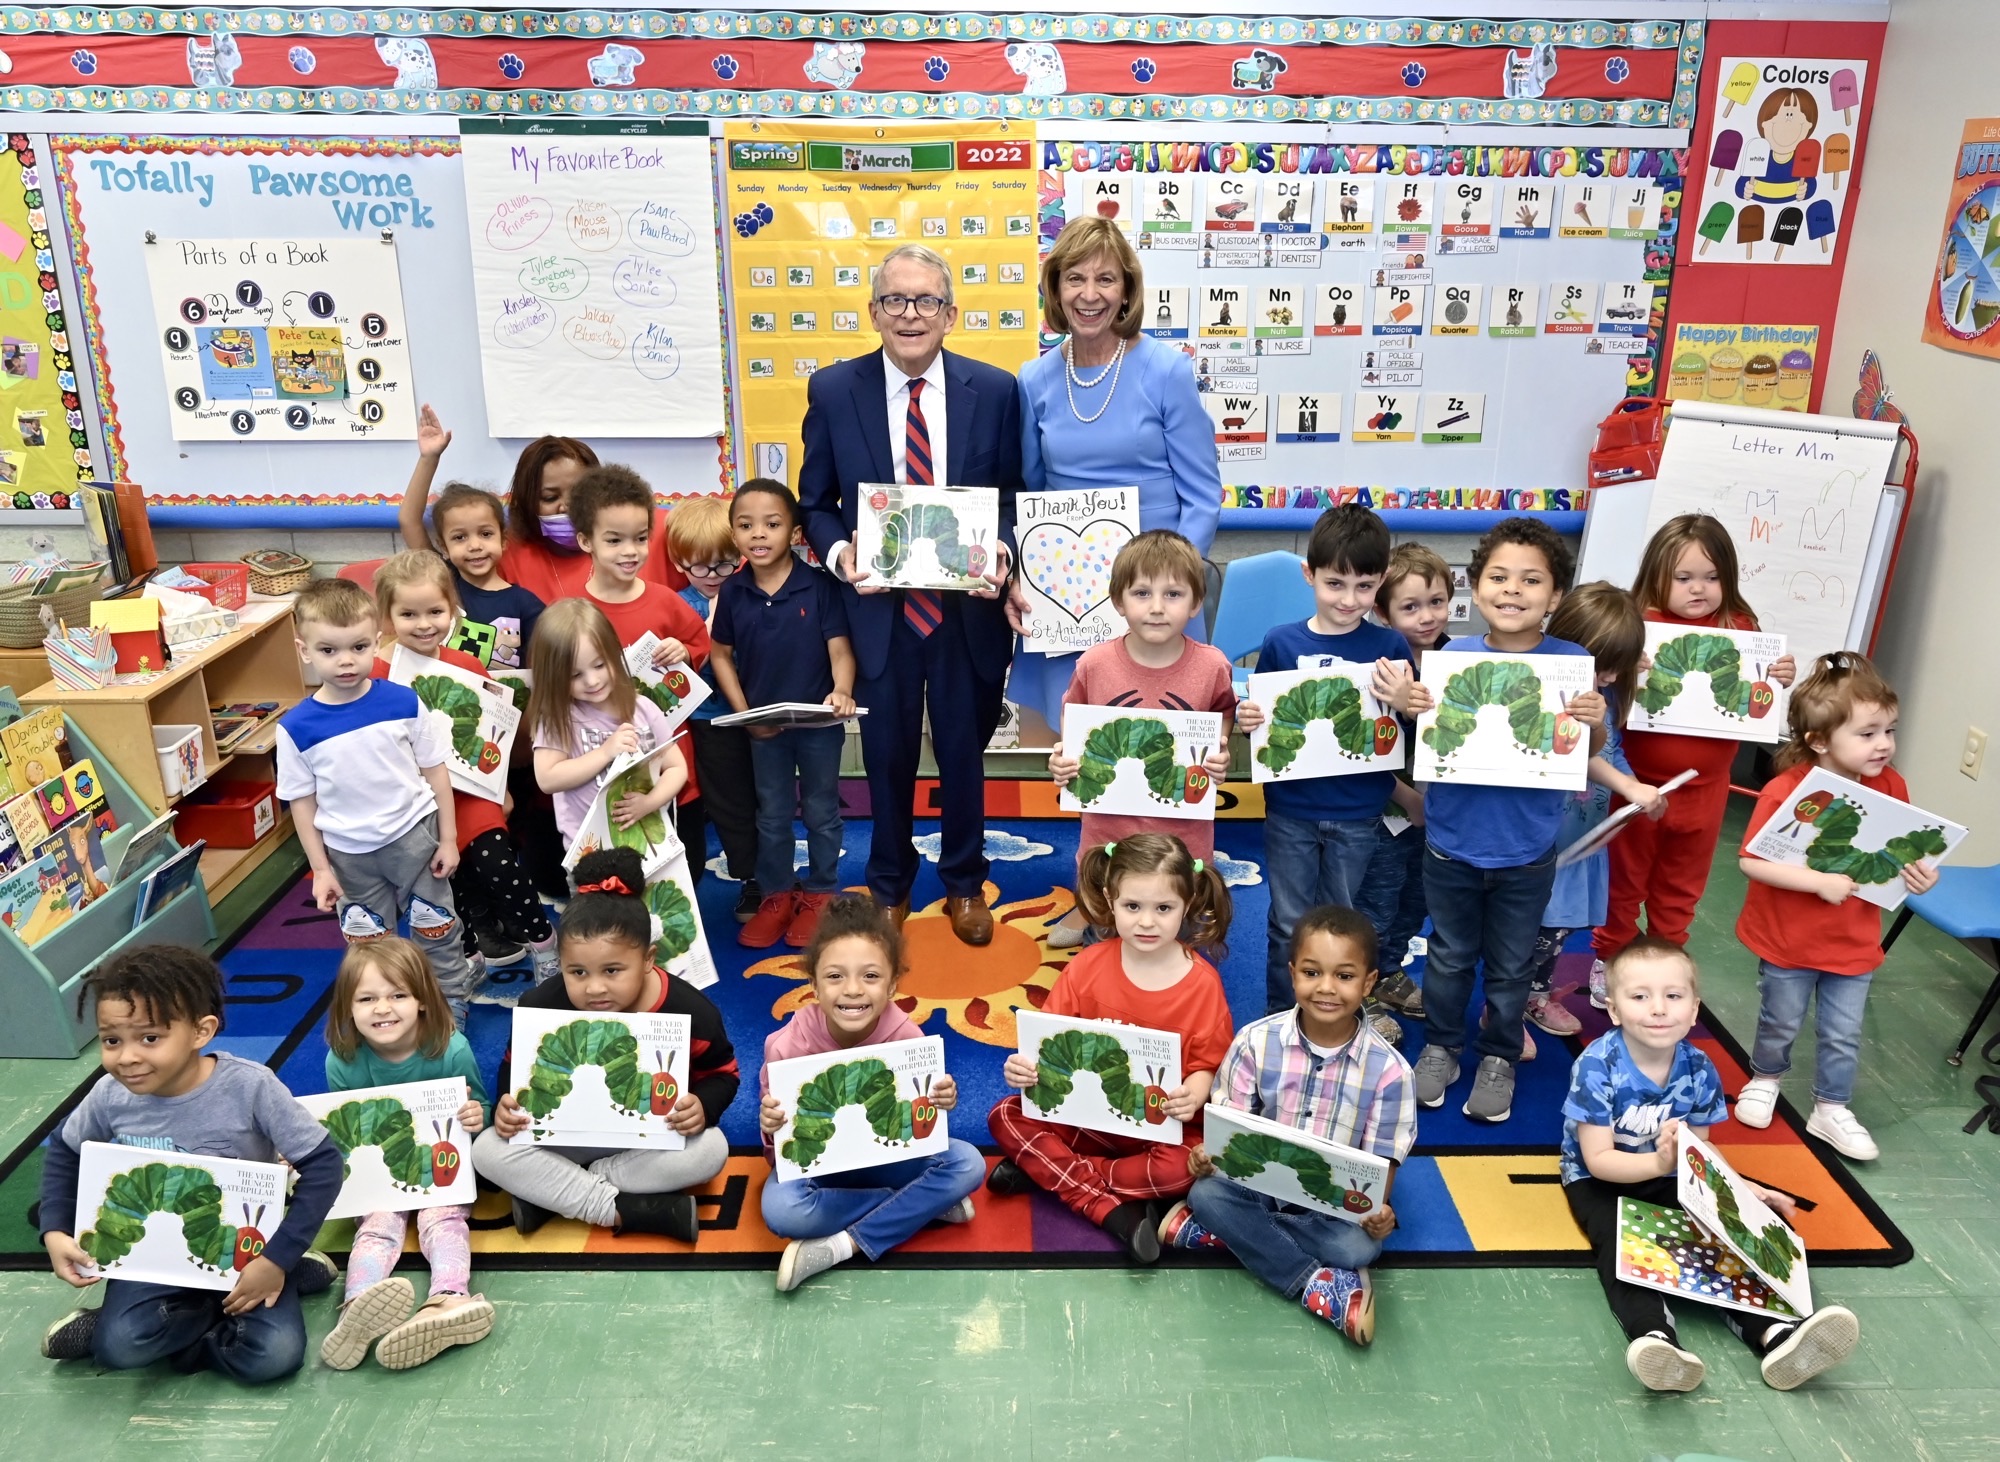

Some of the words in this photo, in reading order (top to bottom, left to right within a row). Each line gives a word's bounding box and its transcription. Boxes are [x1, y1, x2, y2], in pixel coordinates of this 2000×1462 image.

[1763, 64, 1830, 85] Colors
[1730, 80, 1751, 88] yellow
[1983, 126, 1997, 138] Life
[740, 148, 798, 163] Spring
[966, 147, 1022, 162] 2022
[511, 146, 539, 184] My
[620, 147, 665, 170] Book
[862, 155, 910, 168] March
[90, 160, 213, 207] Totally
[248, 164, 414, 197] Pawsome
[737, 184, 765, 194] Sunday
[777, 184, 809, 194] Monday
[822, 184, 852, 194] Tuesday
[858, 183, 902, 193] Wednesday
[906, 182, 941, 192] Thursday
[955, 182, 980, 191] Friday
[992, 180, 1027, 191] Saturday
[1096, 180, 1120, 195] Aa
[1158, 180, 1179, 195] Bb
[1220, 180, 1244, 194] Cc
[1340, 181, 1360, 196] Ee
[1277, 182, 1300, 197] Dd
[1404, 184, 1418, 198] Ff
[1457, 183, 1482, 201] Gg
[1518, 187, 1539, 201] Hh
[1965, 183, 1986, 204] ADULT
[1632, 188, 1646, 206] Jj
[332, 198, 434, 231] Work
[643, 201, 677, 221] ISAAC
[574, 215, 608, 229] Mouse
[1160, 222, 1175, 230] Bird
[1223, 221, 1237, 229] Car
[1278, 223, 1294, 232] Dog
[1331, 223, 1364, 233] Elephant
[1395, 224, 1420, 232] Flower
[1454, 225, 1478, 233] Goose
[1514, 227, 1535, 236] Hand
[1563, 228, 1576, 236] Ice
[1577, 229, 1603, 237] cream
[1623, 228, 1643, 238] Juice
[1156, 237, 1170, 245] BUS
[1218, 236, 1259, 245] CUSTODIAN
[1281, 236, 1316, 246] DOCTOR
[1340, 238, 1366, 247] earth
[1460, 236, 1492, 244] GARBAGE
[176, 241, 227, 265] Parts
[240, 243, 259, 265] of
[267, 251, 277, 265] a
[286, 242, 329, 265] Book
[1456, 244, 1496, 252] COLLECTOR
[1281, 254, 1316, 264] DENTIST
[629, 255, 662, 277] Tylee
[1390, 273, 1431, 281] FIREFIGHTER
[547, 282, 570, 293] Big
[622, 274, 660, 296] Sonic
[1209, 288, 1239, 302] Mm
[1269, 288, 1291, 302] Nn
[1328, 287, 1353, 300] Oo
[1390, 287, 1410, 302] Pp
[1446, 287, 1470, 303] Qq
[1508, 289, 1524, 301] Rr
[1566, 286, 1582, 299] Ss
[1623, 285, 1636, 298] Tt
[847, 319, 858, 329] 15
[1555, 324, 1583, 332] Scissors
[1613, 324, 1633, 332] Truck
[278, 329, 302, 341] Pete
[308, 330, 327, 340] Cat
[1155, 328, 1172, 337] Lock
[1208, 328, 1238, 337] Monkey
[1270, 328, 1287, 336] Nuts
[1331, 326, 1346, 334] Owl
[1382, 326, 1413, 335] Popsicle
[1440, 326, 1469, 334] Quarter
[171, 331, 182, 348] 9
[1678, 325, 1737, 346] Happy
[1740, 325, 1817, 347] Birthday!
[1200, 341, 1221, 350] mask
[1274, 341, 1304, 350] NURSE
[1607, 341, 1644, 350] TEACHER
[640, 346, 672, 364] Sonic
[1388, 352, 1414, 360] POLICE
[1226, 357, 1245, 365] MAIL
[1386, 360, 1415, 368] OFFICER
[1677, 362, 1702, 370] January
[1753, 362, 1771, 370] March
[762, 364, 773, 374] 20
[1221, 365, 1250, 373] CARRIER
[1386, 373, 1415, 382] PILOT
[1214, 380, 1257, 390] MECHANIC
[1224, 398, 1252, 410] Ww
[1299, 396, 1318, 409] Xx
[1378, 395, 1396, 411] Yy
[1447, 398, 1464, 411] Zz
[194, 410, 230, 419] Illustrator
[365, 403, 380, 420] 10
[312, 417, 336, 426] Author
[347, 421, 374, 437] Pages
[1224, 434, 1250, 442] Wagon
[1296, 434, 1317, 442] X-ray
[1376, 433, 1392, 441] Yarn
[1441, 434, 1464, 443] Zipper
[1227, 447, 1262, 457] WRITER
[1732, 435, 1784, 455] Letter
[1795, 441, 1834, 462] Mm
[1023, 496, 1081, 519] Thank
[1082, 490, 1126, 517] You!
[1068, 636, 1092, 647] Head
[1755, 643, 1780, 651] HUNGRY
[1739, 648, 1780, 657] CATERPILLAR
[8, 722, 39, 749] David
[1172, 731, 1216, 739] CATERPILLAR
[21, 735, 55, 758] Trouble
[17, 752, 27, 766] in
[13, 884, 27, 898] GOES
[16, 887, 41, 908] SCHOOL
[665, 1020, 683, 1028] VERY
[654, 1027, 683, 1035] HUNGRY
[635, 1034, 683, 1042] CATERPILLAR
[1138, 1036, 1152, 1045] THE
[1152, 1039, 1170, 1048] VERY
[903, 1048, 918, 1056] THE
[918, 1045, 937, 1053] VERY
[1125, 1048, 1172, 1061] CATERPILLAR
[1142, 1044, 1171, 1054] HUNGRY
[908, 1052, 937, 1062] HUNGRY
[891, 1059, 938, 1072] CATERPILLAR
[423, 1089, 437, 1098] THE
[438, 1087, 457, 1096] VERY
[427, 1095, 457, 1104] HUNGRY
[410, 1102, 459, 1114] CATERPILLAR
[237, 1170, 254, 1179] THE
[255, 1172, 276, 1181] VERY
[241, 1179, 275, 1189] HUNGRY
[219, 1183, 275, 1197] CATERPILLAR
